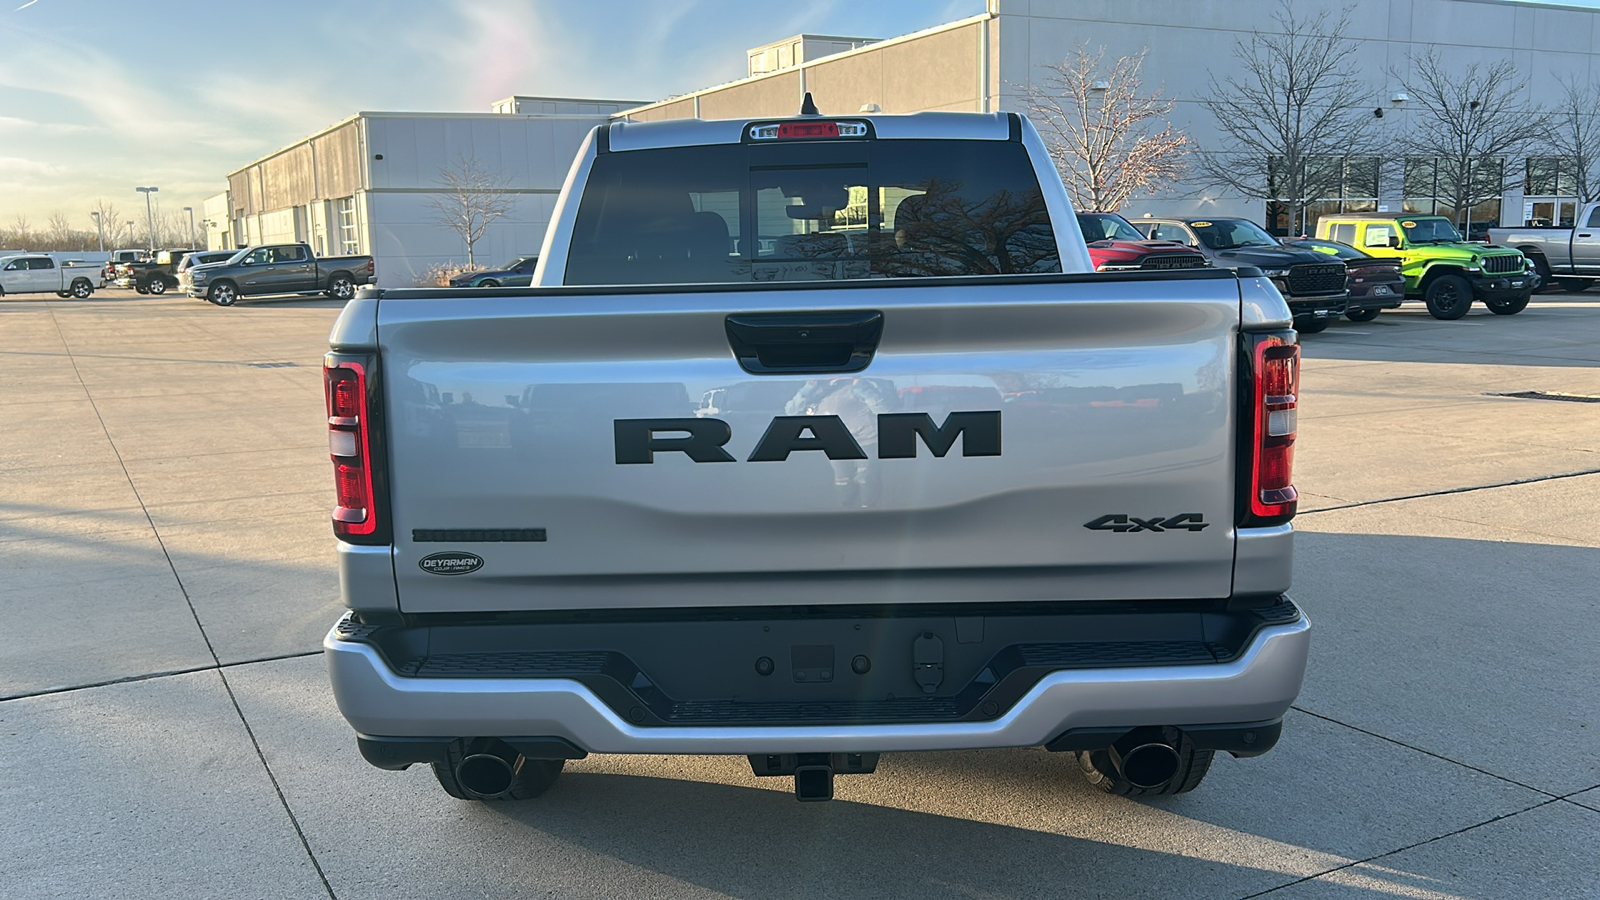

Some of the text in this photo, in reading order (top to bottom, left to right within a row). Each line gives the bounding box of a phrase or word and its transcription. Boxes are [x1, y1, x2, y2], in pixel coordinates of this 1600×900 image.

[613, 410, 1002, 465] RAM
[1083, 513, 1210, 533] 4x4
[423, 558, 478, 567] DEYARMAN
